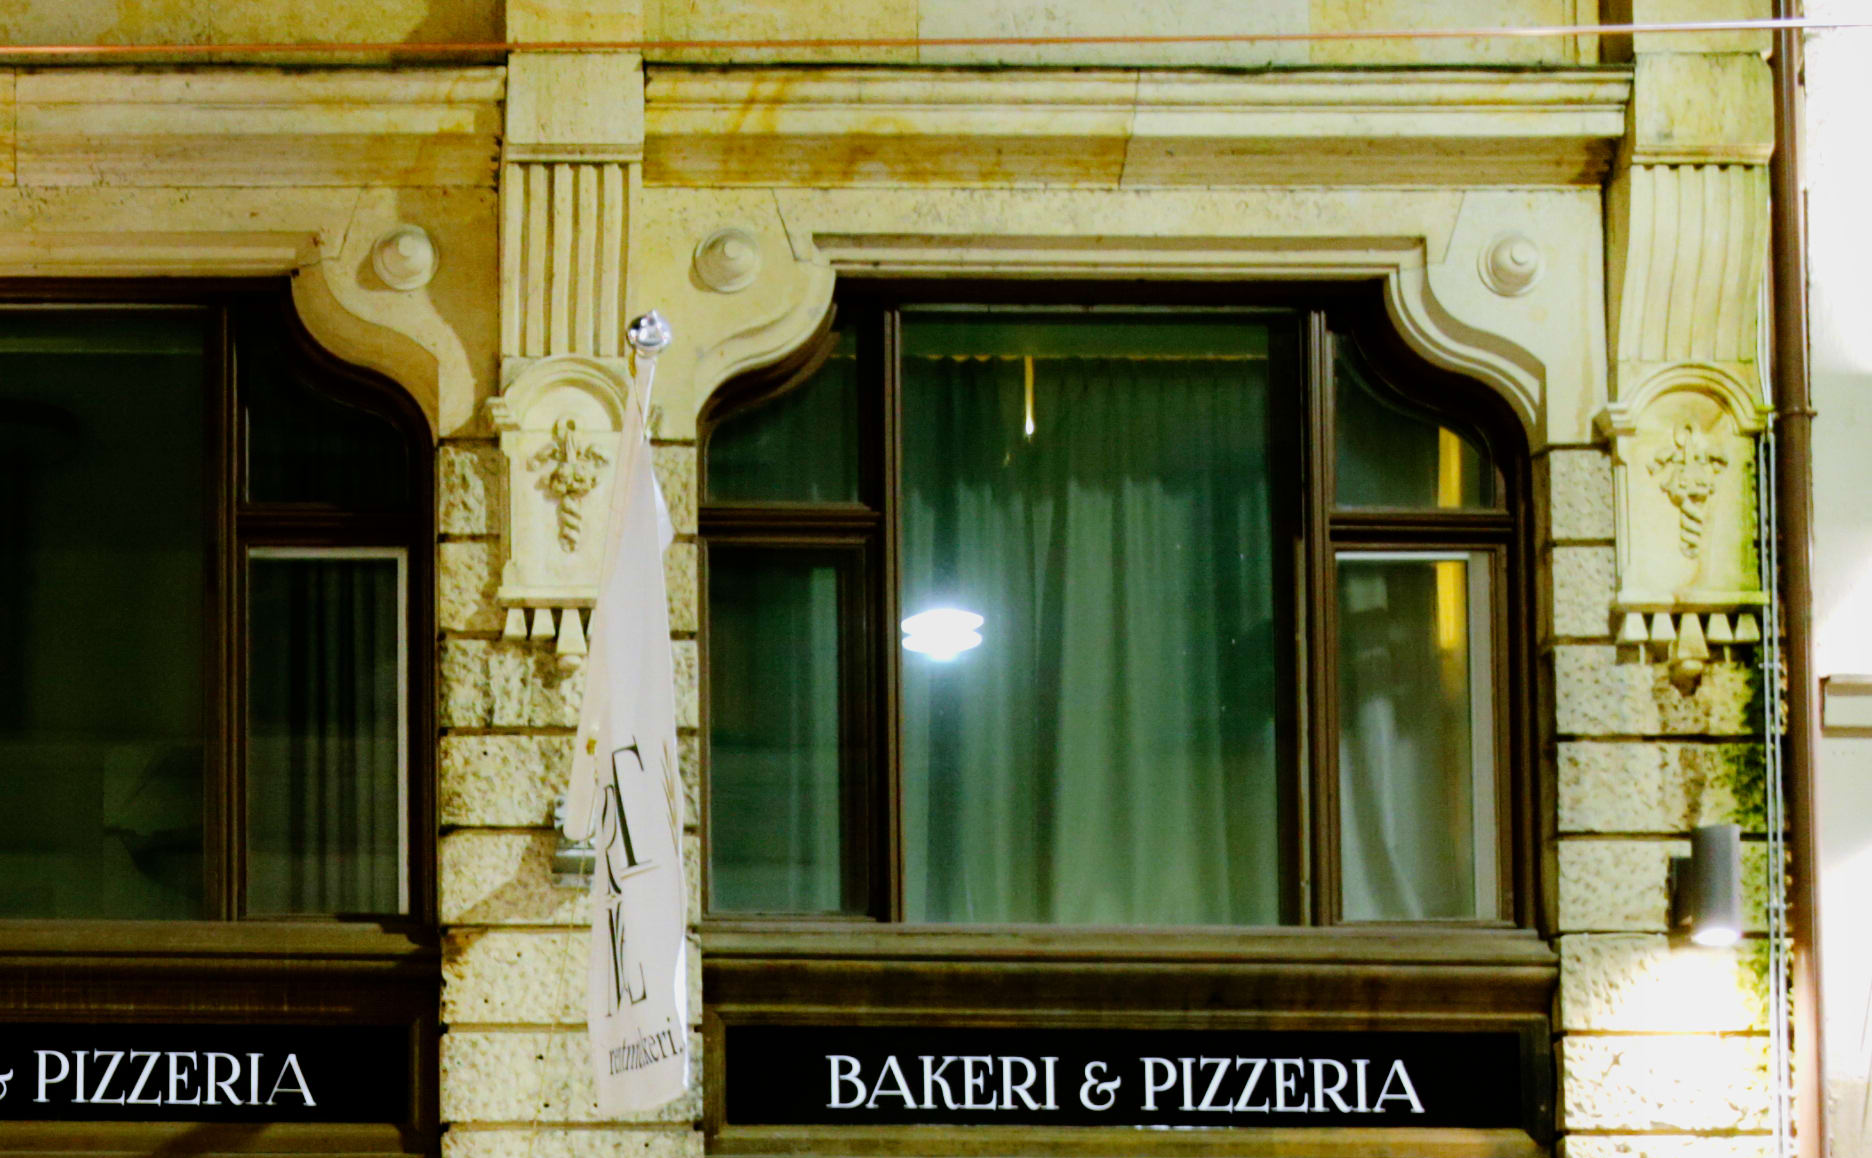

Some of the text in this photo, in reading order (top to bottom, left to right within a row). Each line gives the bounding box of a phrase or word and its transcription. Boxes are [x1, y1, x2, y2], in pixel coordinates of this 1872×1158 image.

[33, 1049, 317, 1107] PIZZERIA
[825, 1054, 1425, 1114] BAKERI & PIZZERIA
